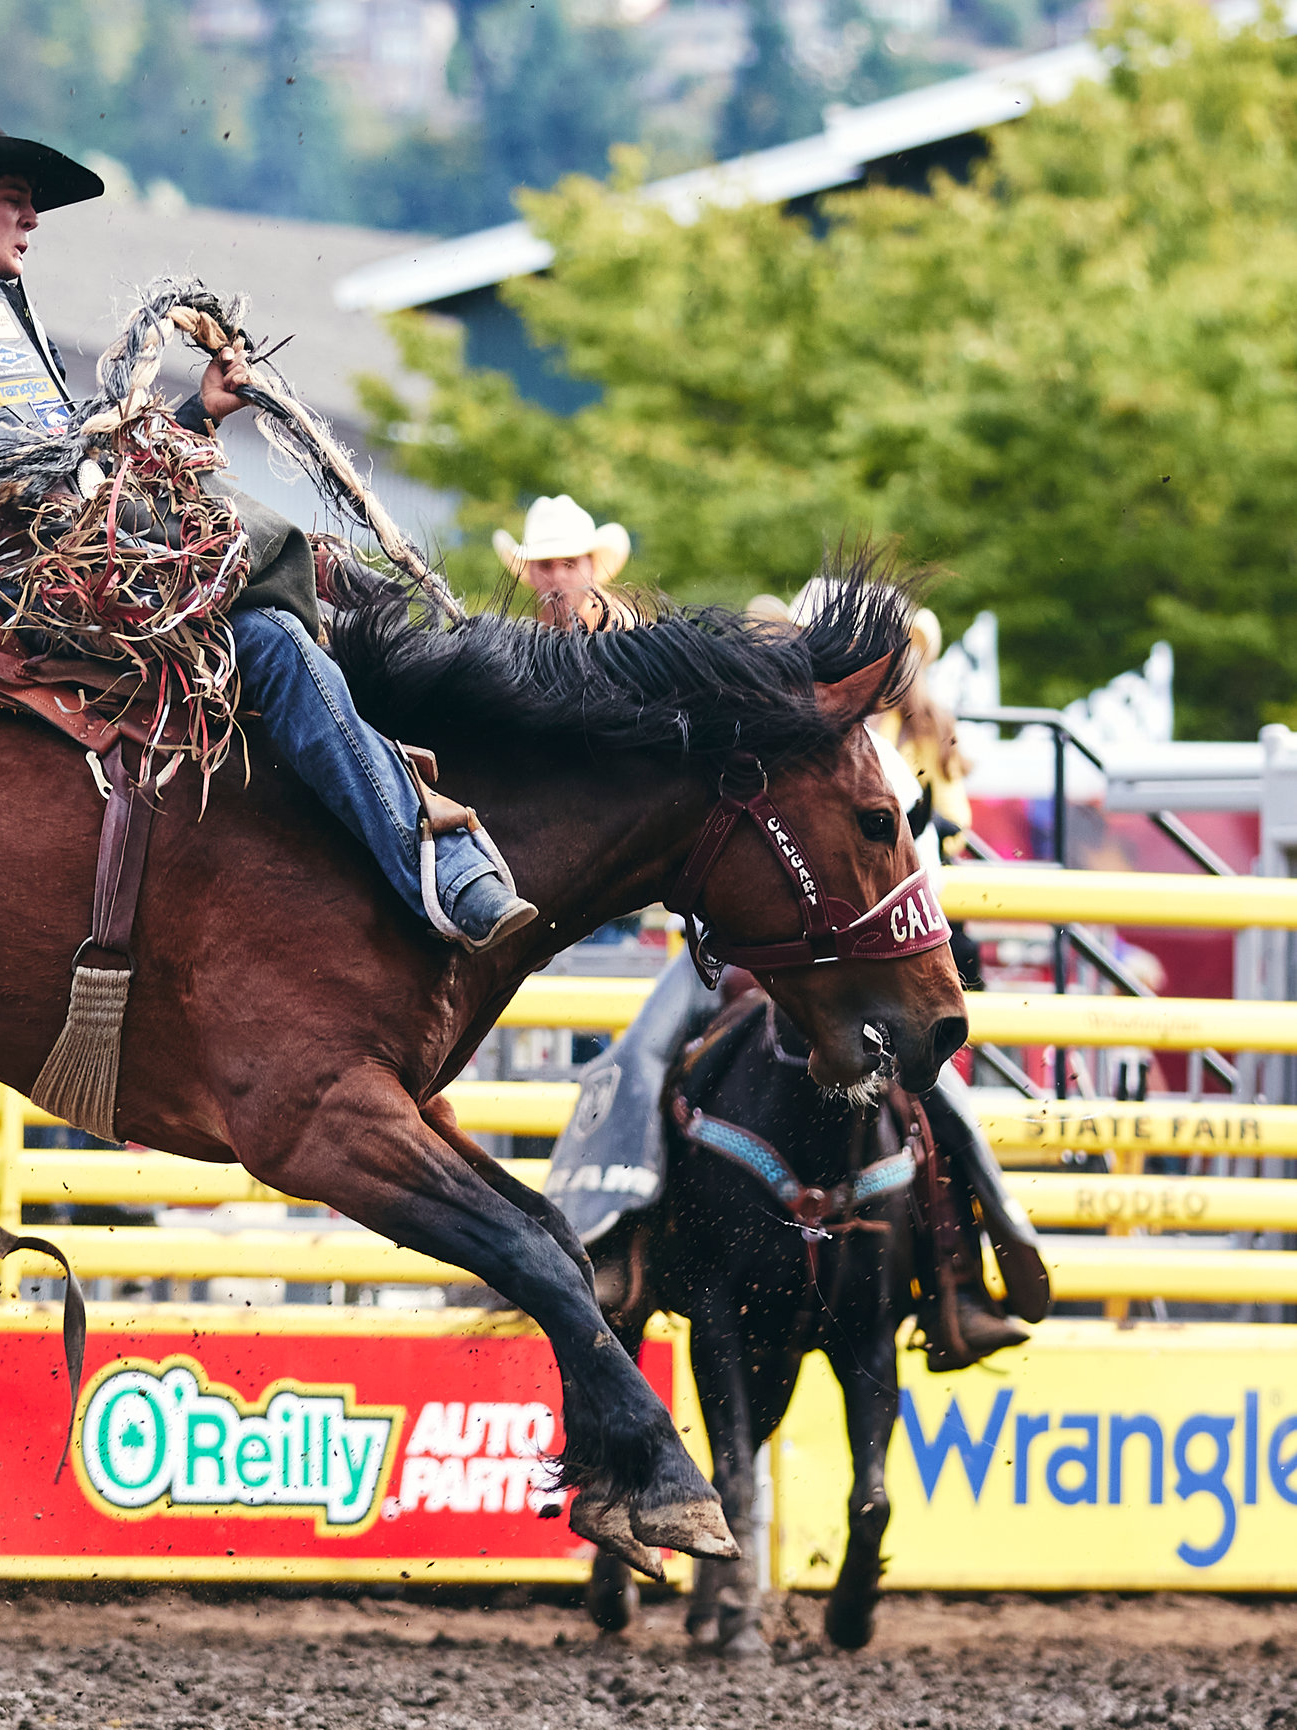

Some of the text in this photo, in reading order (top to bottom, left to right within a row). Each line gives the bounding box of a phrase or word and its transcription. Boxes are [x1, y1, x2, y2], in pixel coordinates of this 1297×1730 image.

[766, 817, 818, 906] CALGARY
[890, 887, 943, 943] CAL
[1024, 1112, 1262, 1141] STATE FAIR
[1075, 1189, 1209, 1217] RODEO
[98, 1382, 373, 1507] O'Reilly
[405, 1401, 555, 1457] AUTO
